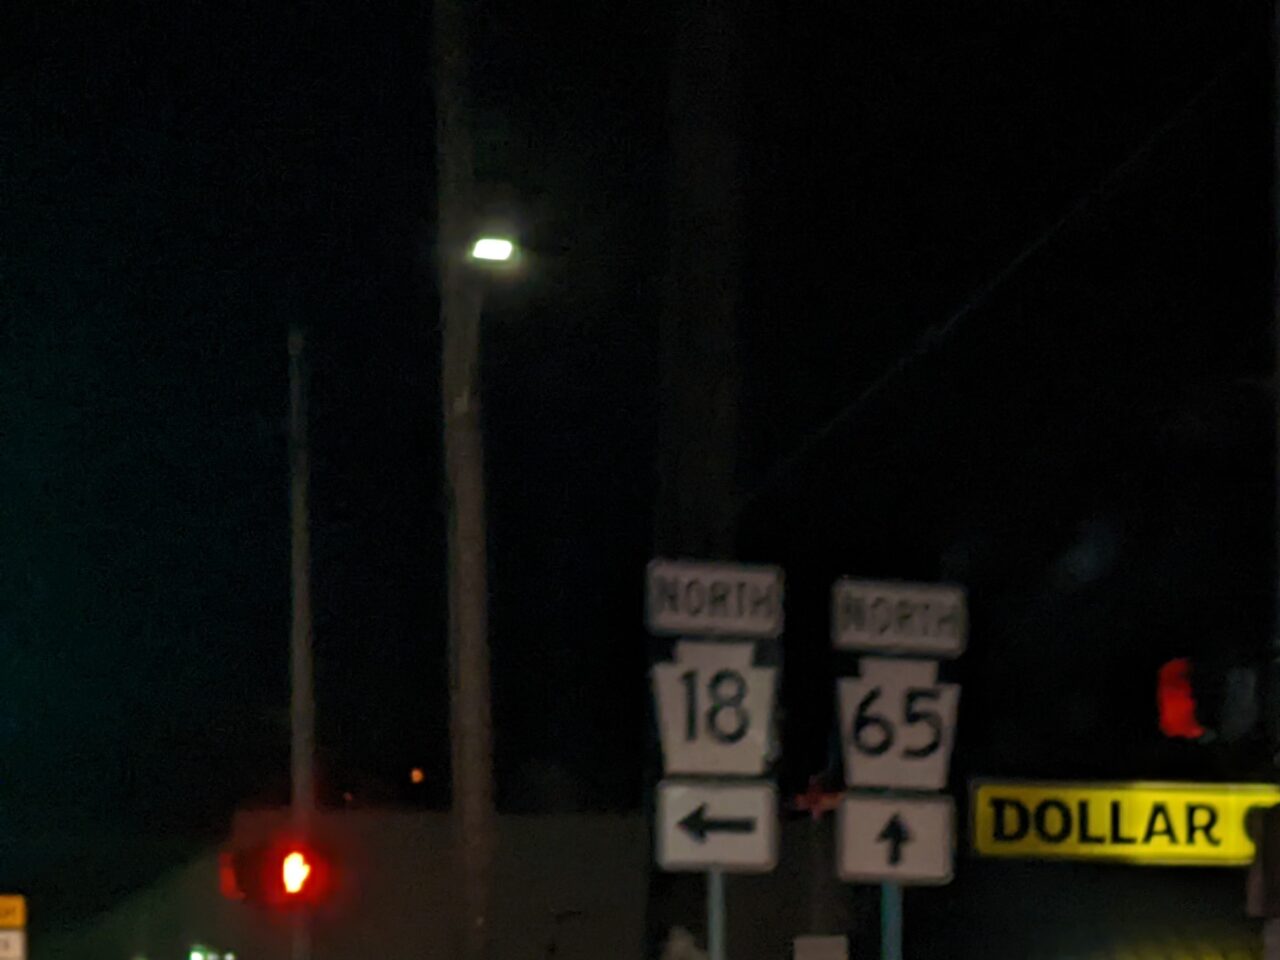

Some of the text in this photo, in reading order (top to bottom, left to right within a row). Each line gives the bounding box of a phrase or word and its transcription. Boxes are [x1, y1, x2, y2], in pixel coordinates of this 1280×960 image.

[655, 575, 776, 619] NORTH
[680, 669, 749, 744] 18
[851, 687, 942, 758] 65
[988, 797, 1222, 846] DOLLAR
